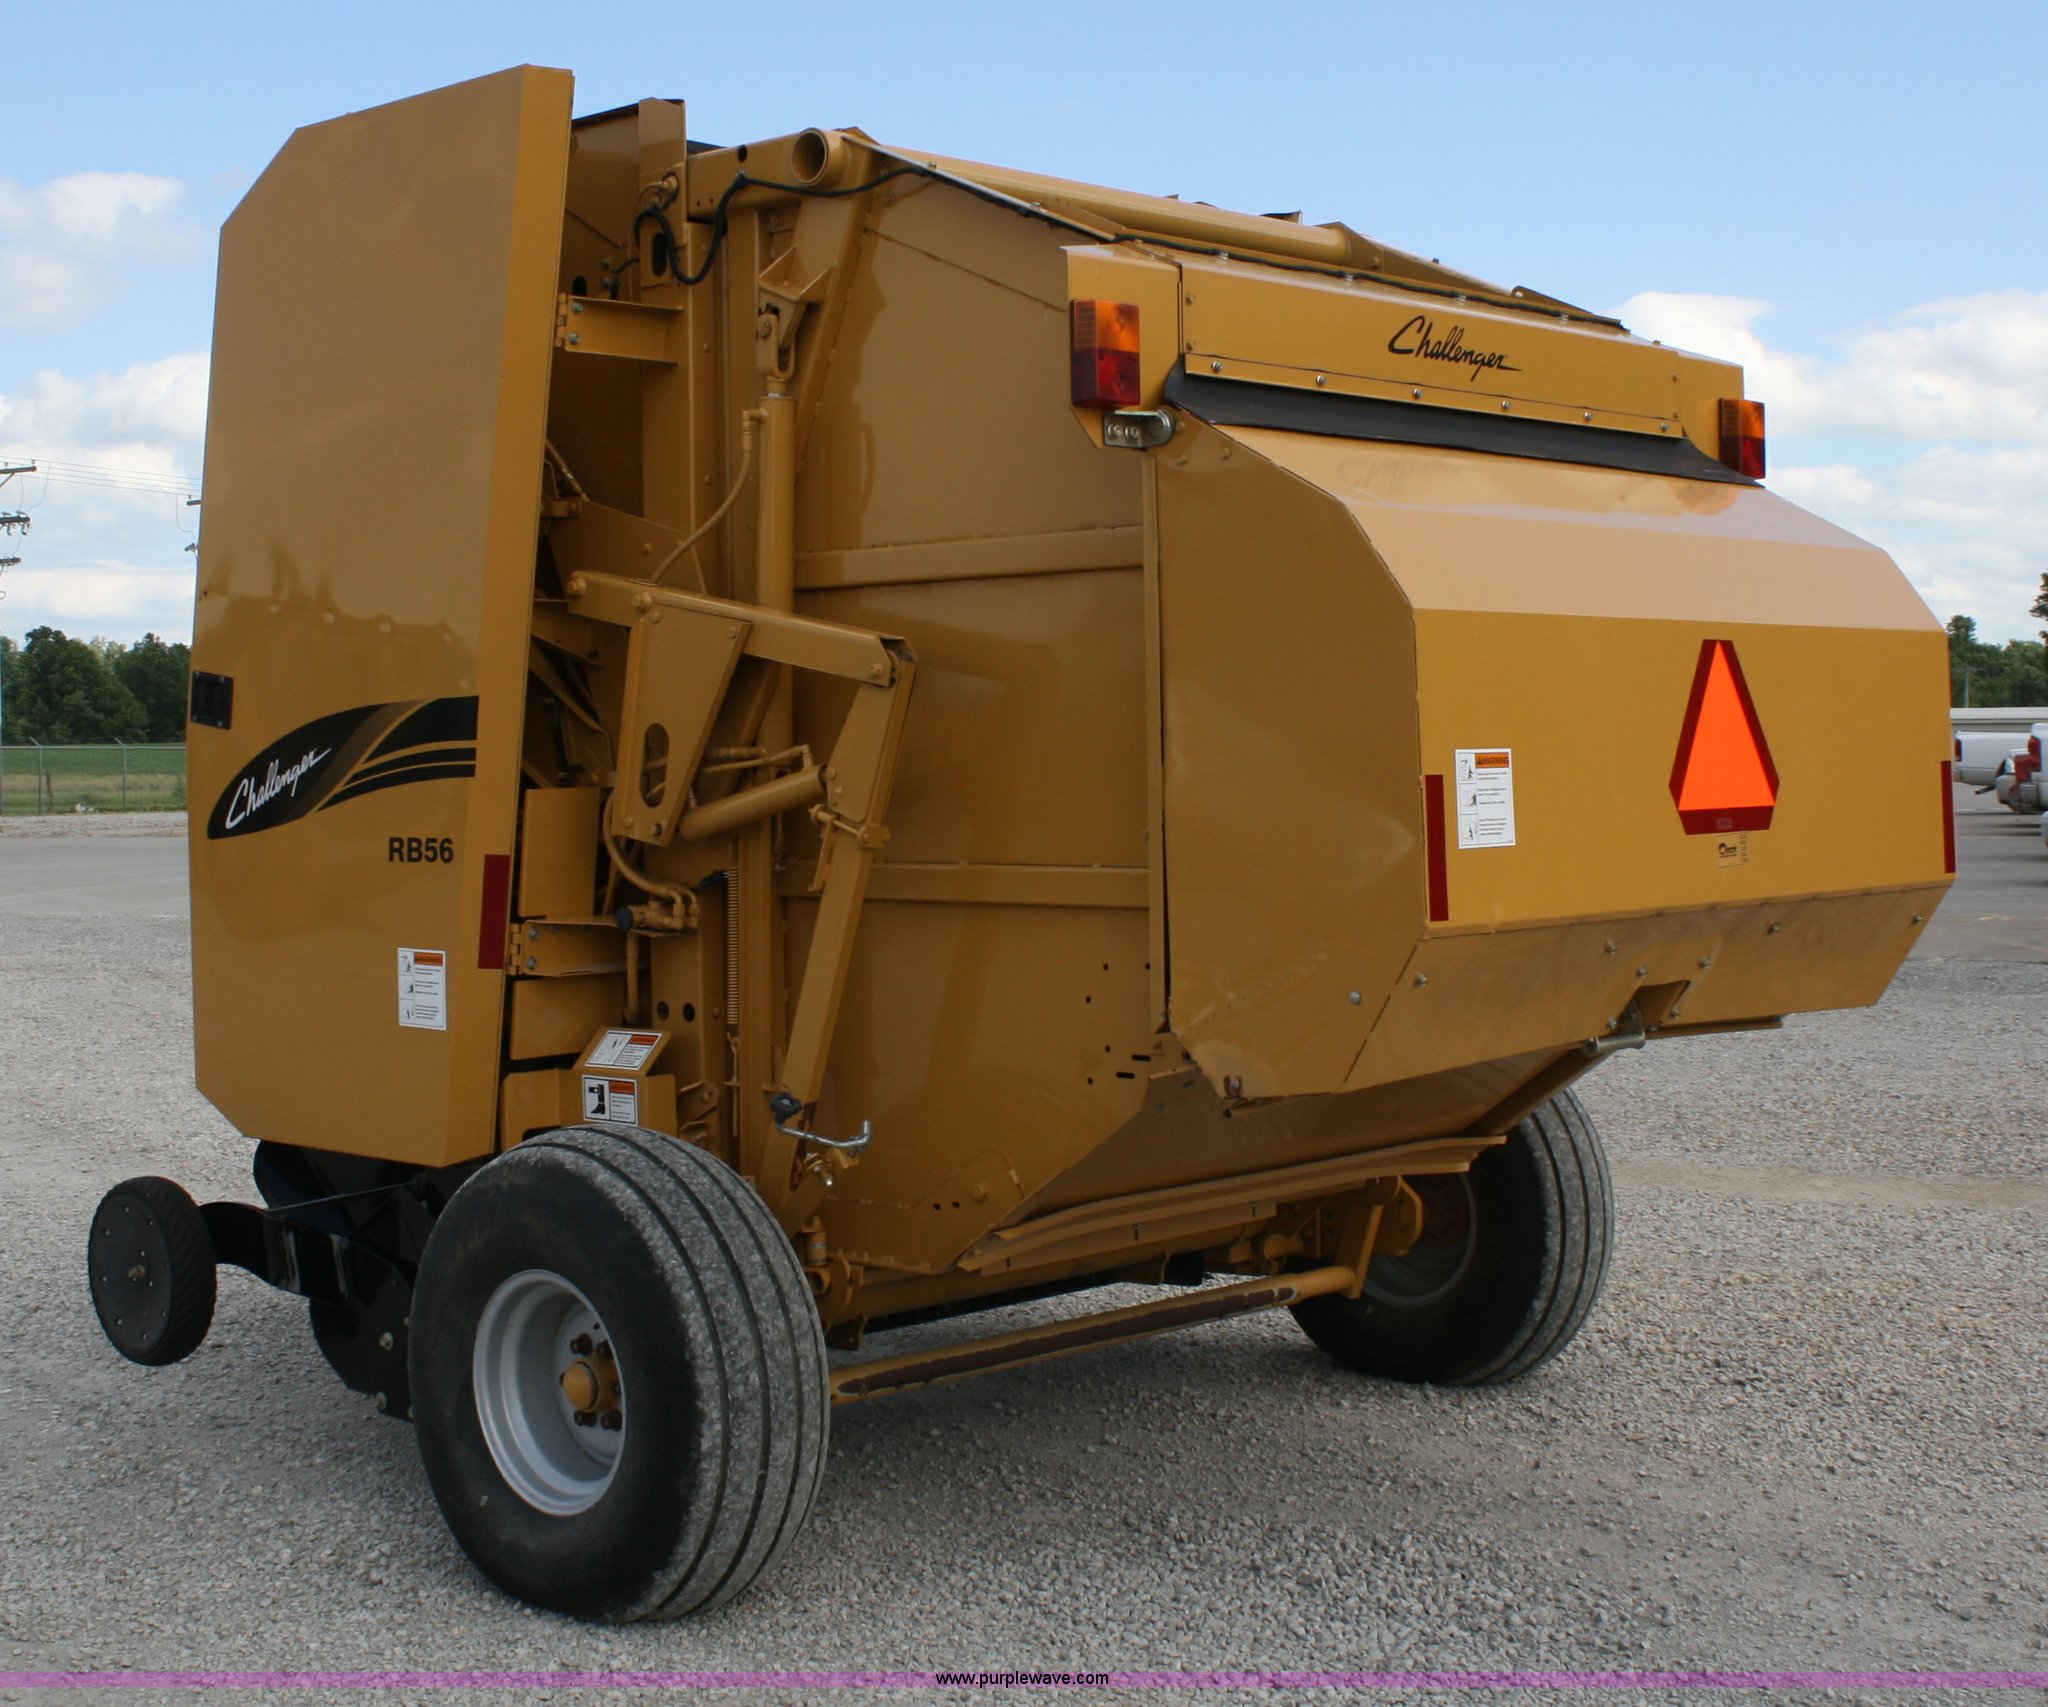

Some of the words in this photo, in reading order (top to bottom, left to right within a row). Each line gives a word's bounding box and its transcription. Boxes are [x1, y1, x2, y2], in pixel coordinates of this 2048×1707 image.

[1388, 315, 1523, 382] Challenger
[225, 748, 332, 830] Challenger
[388, 837, 454, 863] RB56
